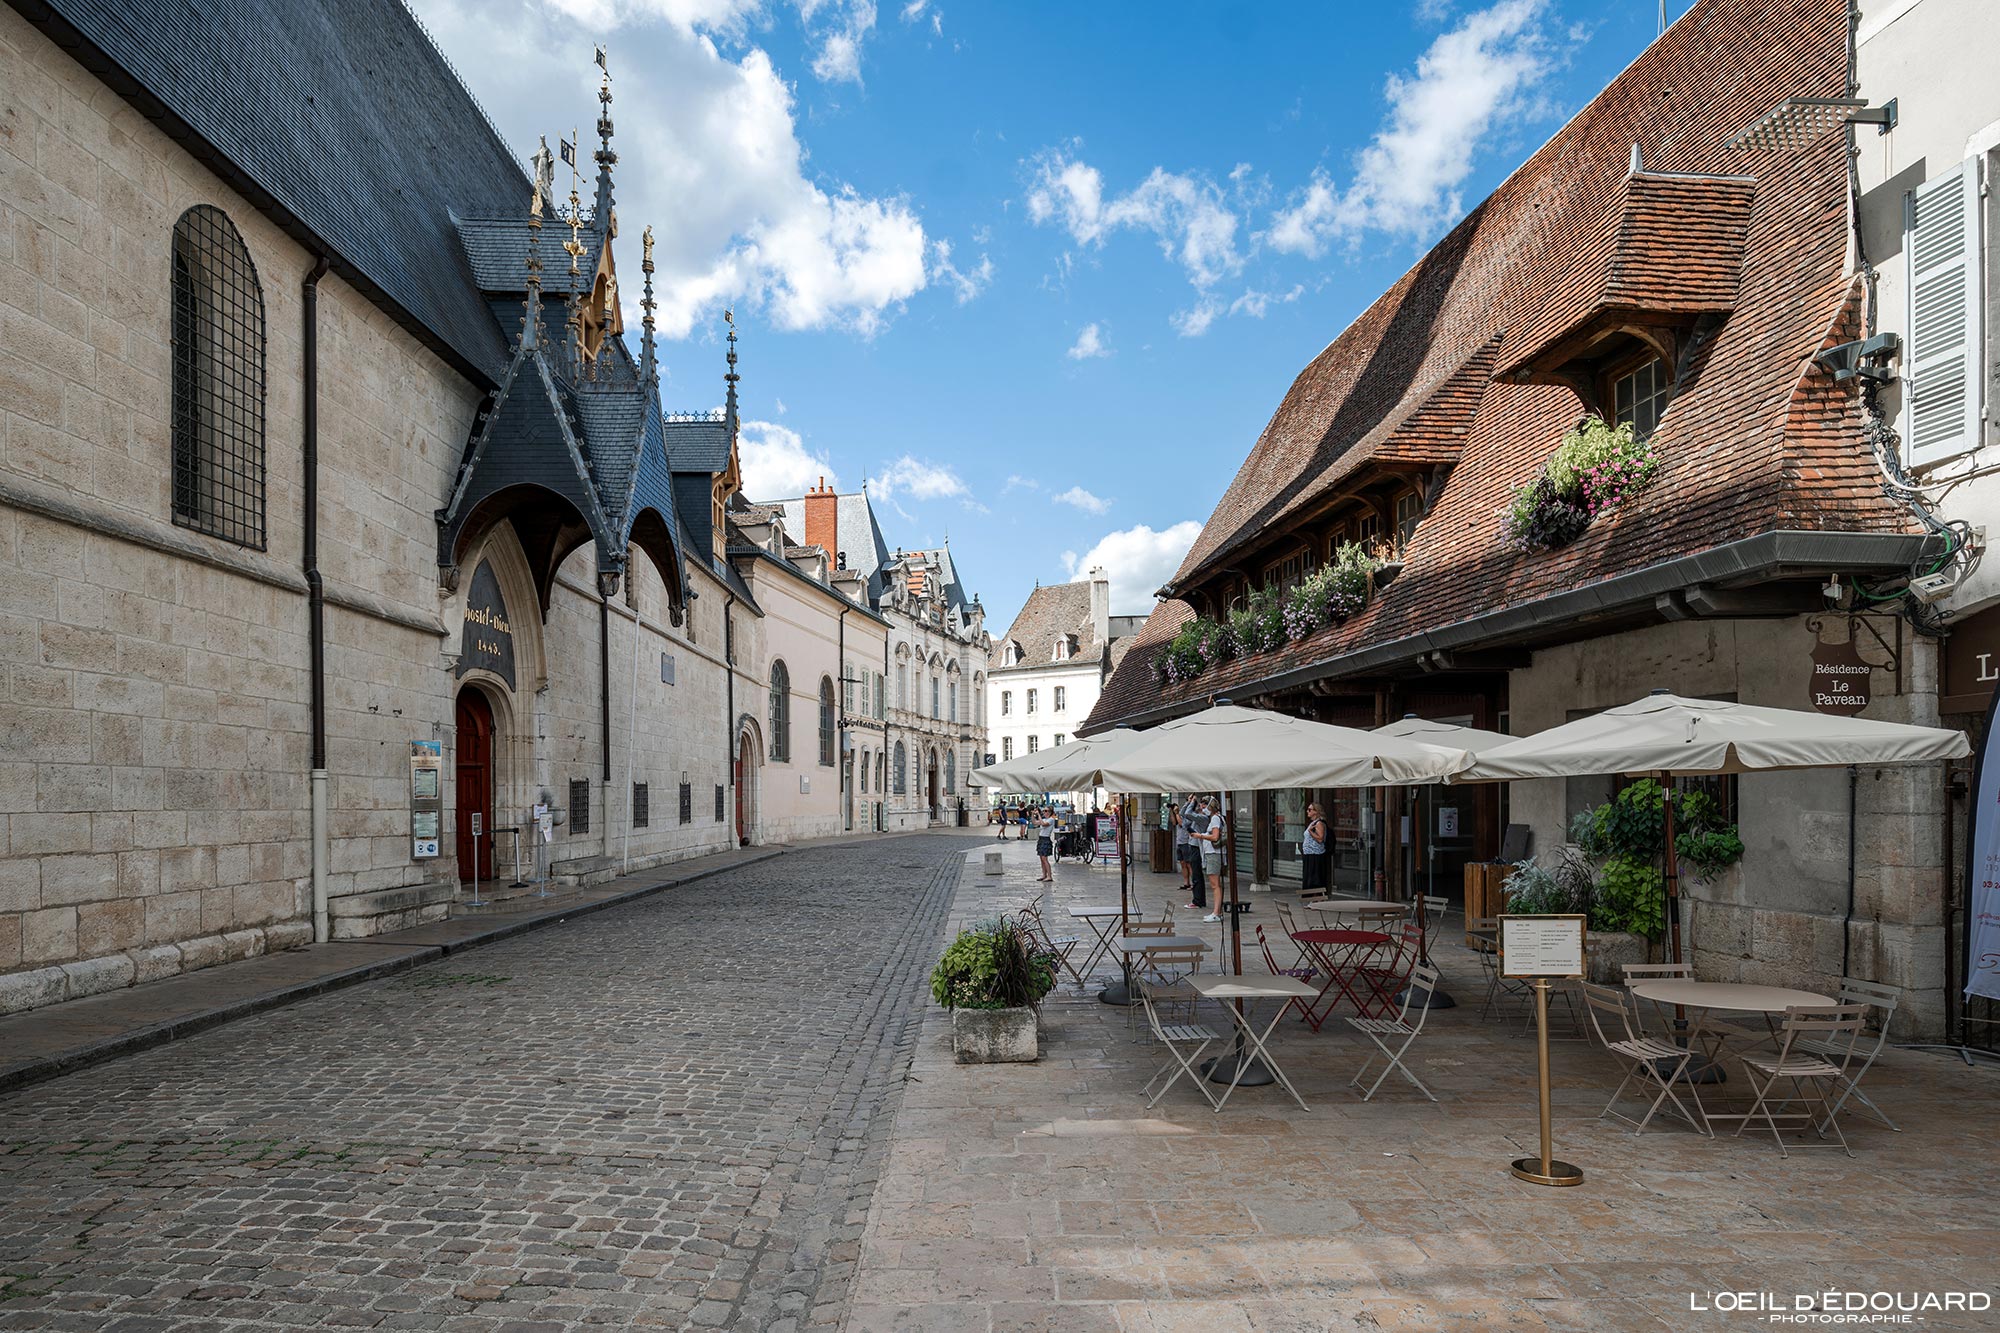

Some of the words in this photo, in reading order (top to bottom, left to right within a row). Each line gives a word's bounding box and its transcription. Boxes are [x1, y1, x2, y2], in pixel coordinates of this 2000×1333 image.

[1815, 663, 1870, 674] Résidence
[1831, 679, 1849, 692] Le
[1815, 692, 1867, 706] Pavean
